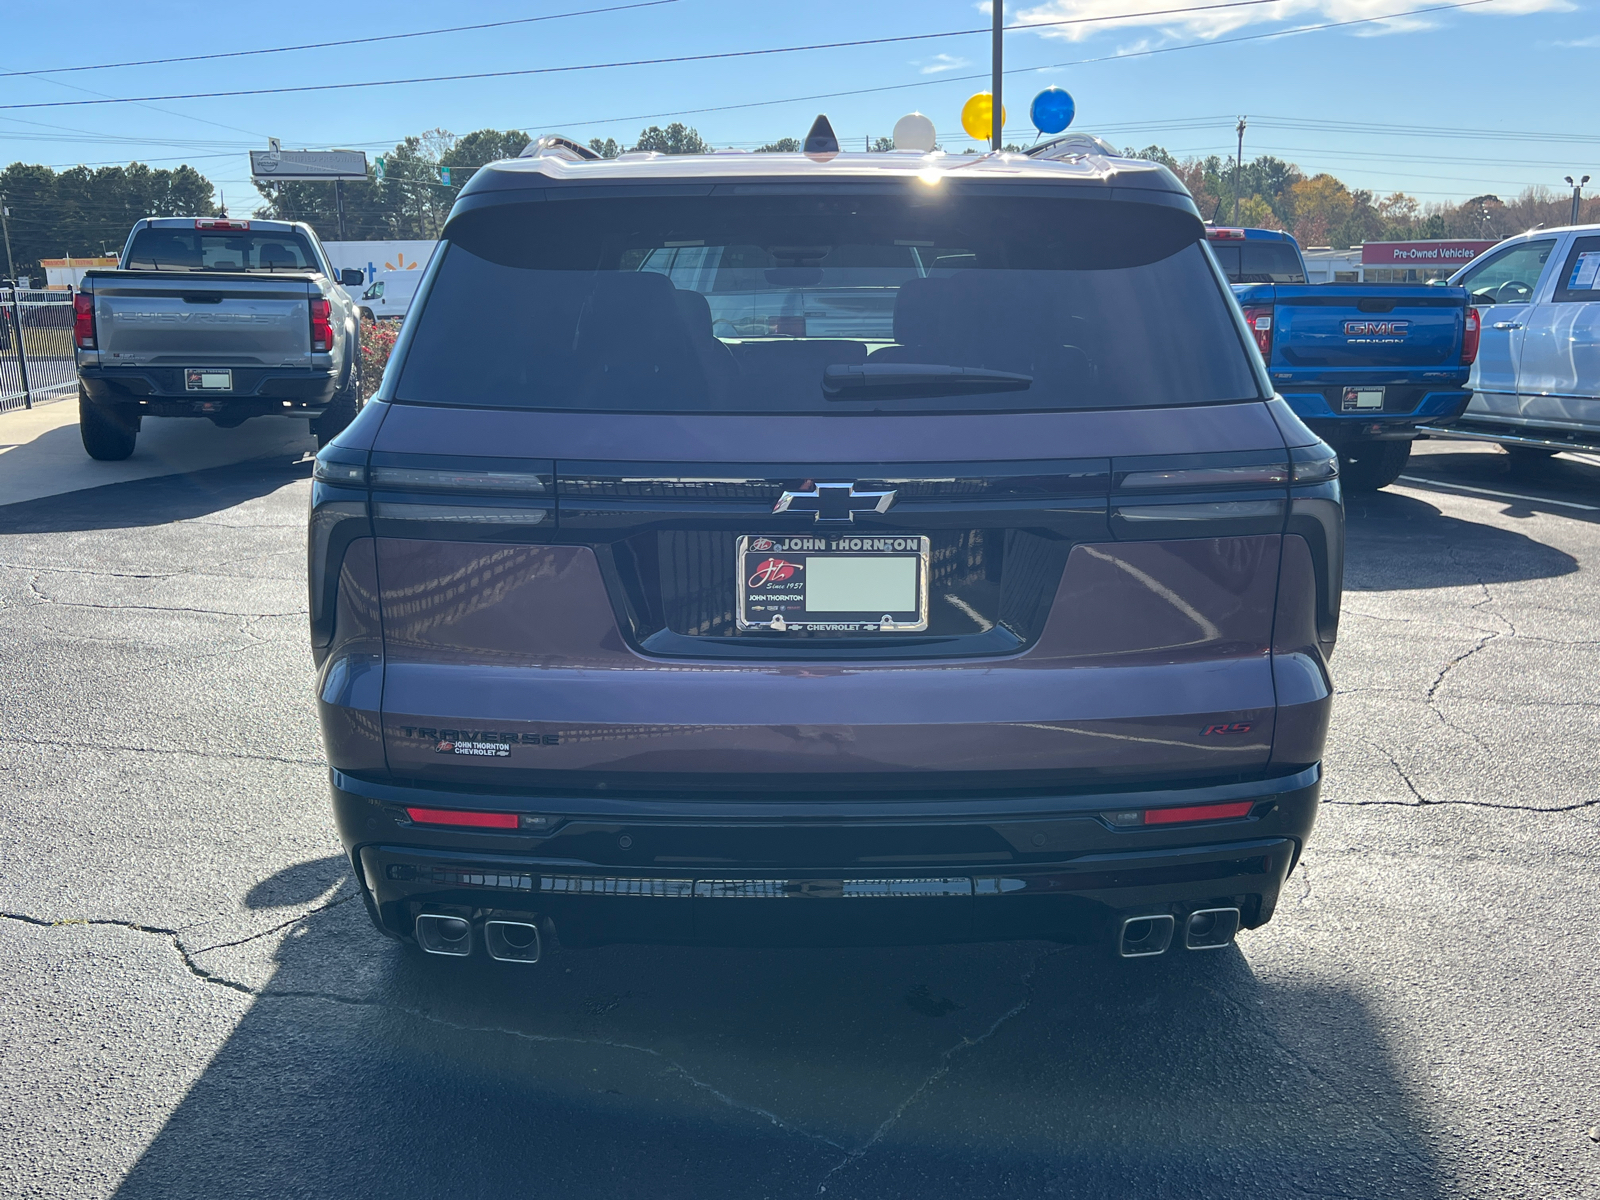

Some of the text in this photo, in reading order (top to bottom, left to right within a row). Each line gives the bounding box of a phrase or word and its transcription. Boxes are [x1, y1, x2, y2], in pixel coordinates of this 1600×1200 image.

[1393, 247, 1475, 259] Pre-Owned Vehicles
[116, 312, 286, 325] CHEVROLET
[1344, 321, 1409, 336] GMC
[782, 538, 826, 550] JOHN
[830, 538, 918, 550] THORNTON
[766, 582, 804, 590] Since 1957
[1199, 721, 1251, 736] RS
[401, 725, 560, 746] TRAVERSE
[454, 741, 472, 749] JOHN
[472, 742, 510, 751] THORNTON
[454, 748, 496, 756] CHEVROLET
